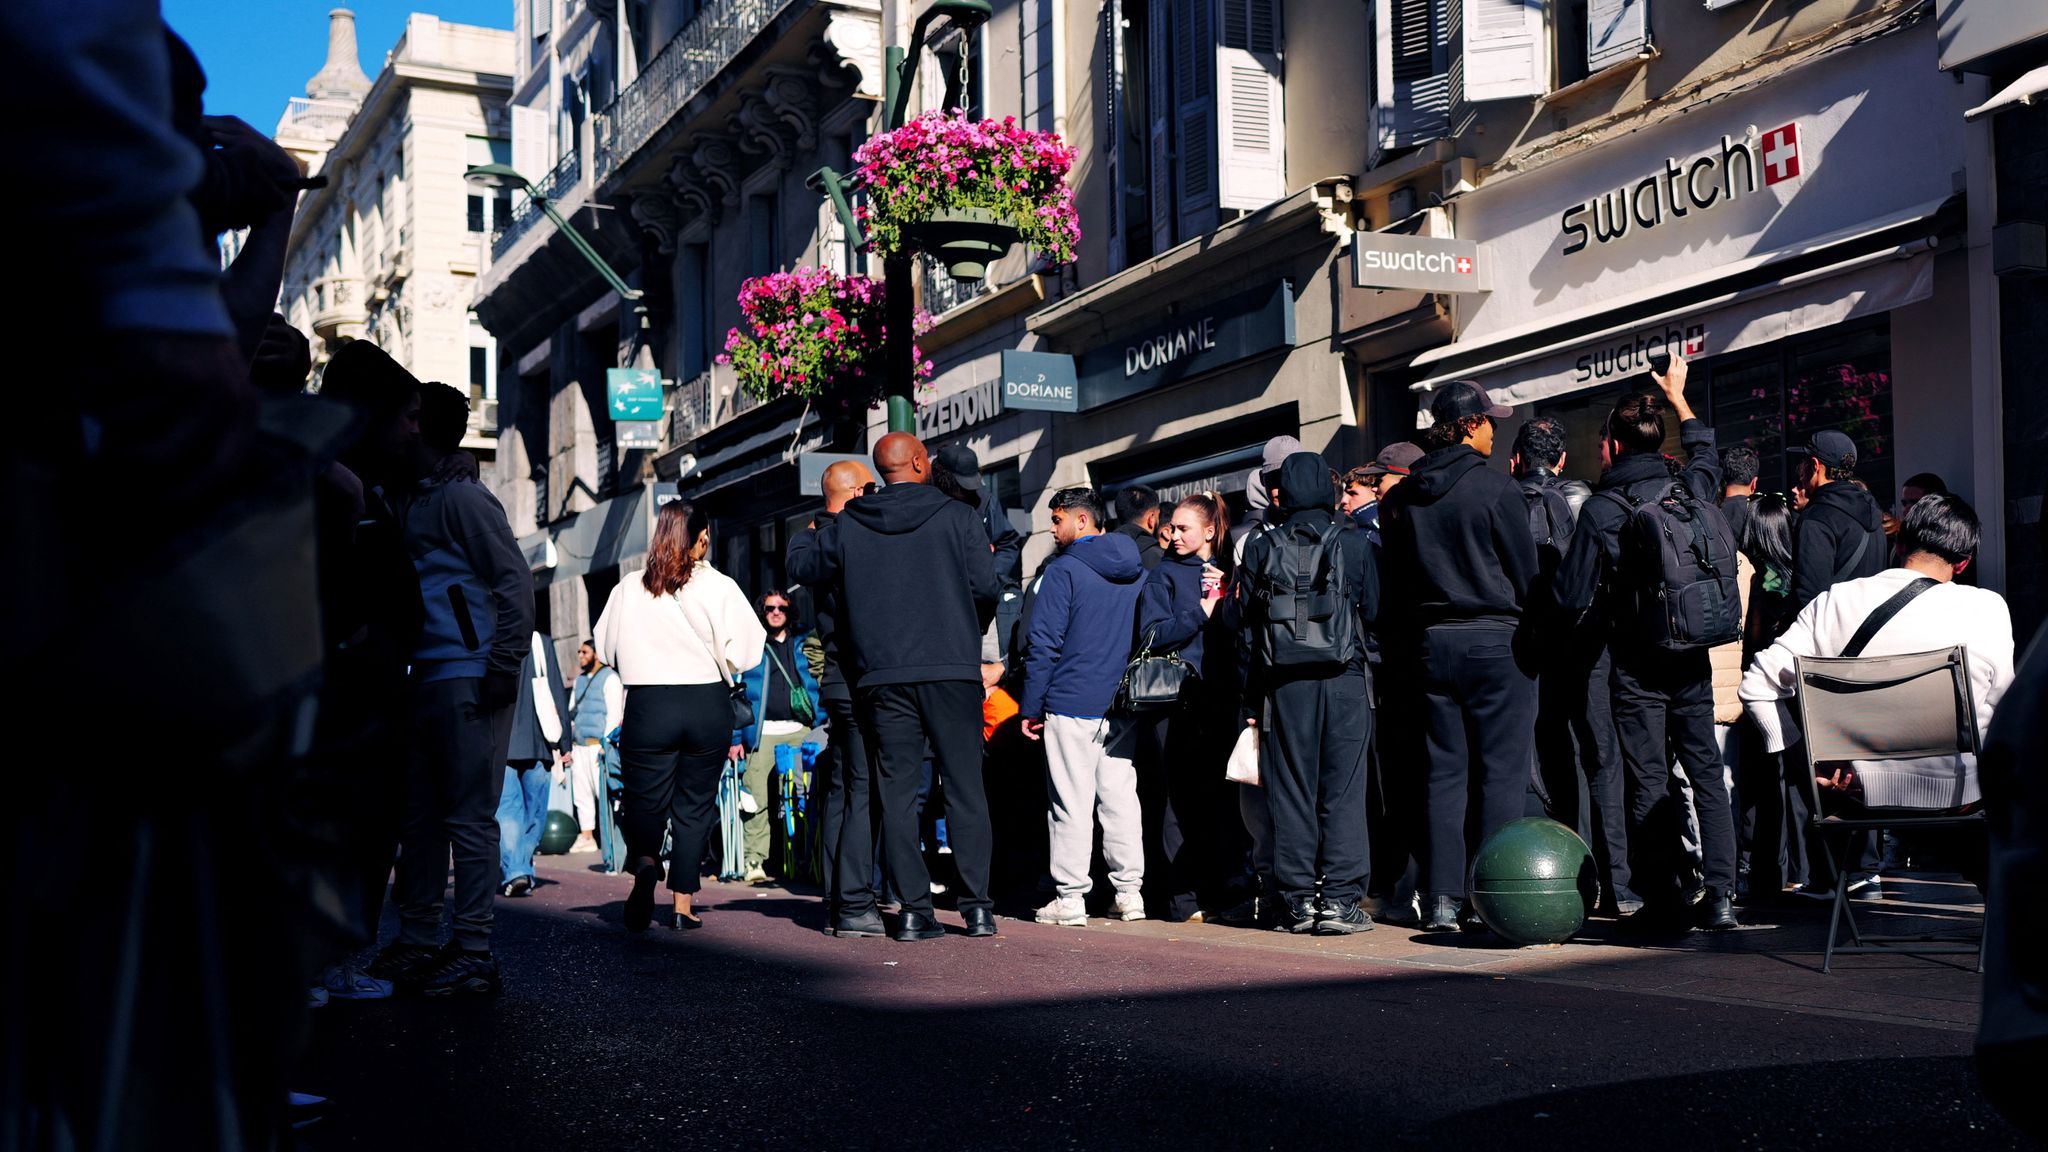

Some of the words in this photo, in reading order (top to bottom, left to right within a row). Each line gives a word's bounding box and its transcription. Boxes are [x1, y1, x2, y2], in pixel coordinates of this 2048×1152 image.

[1562, 134, 1757, 256] swatch
[1365, 250, 1456, 273] swatch
[1126, 316, 1216, 376] DORIANE
[1576, 326, 1682, 383] swatch
[1007, 381, 1073, 400] DORIANE
